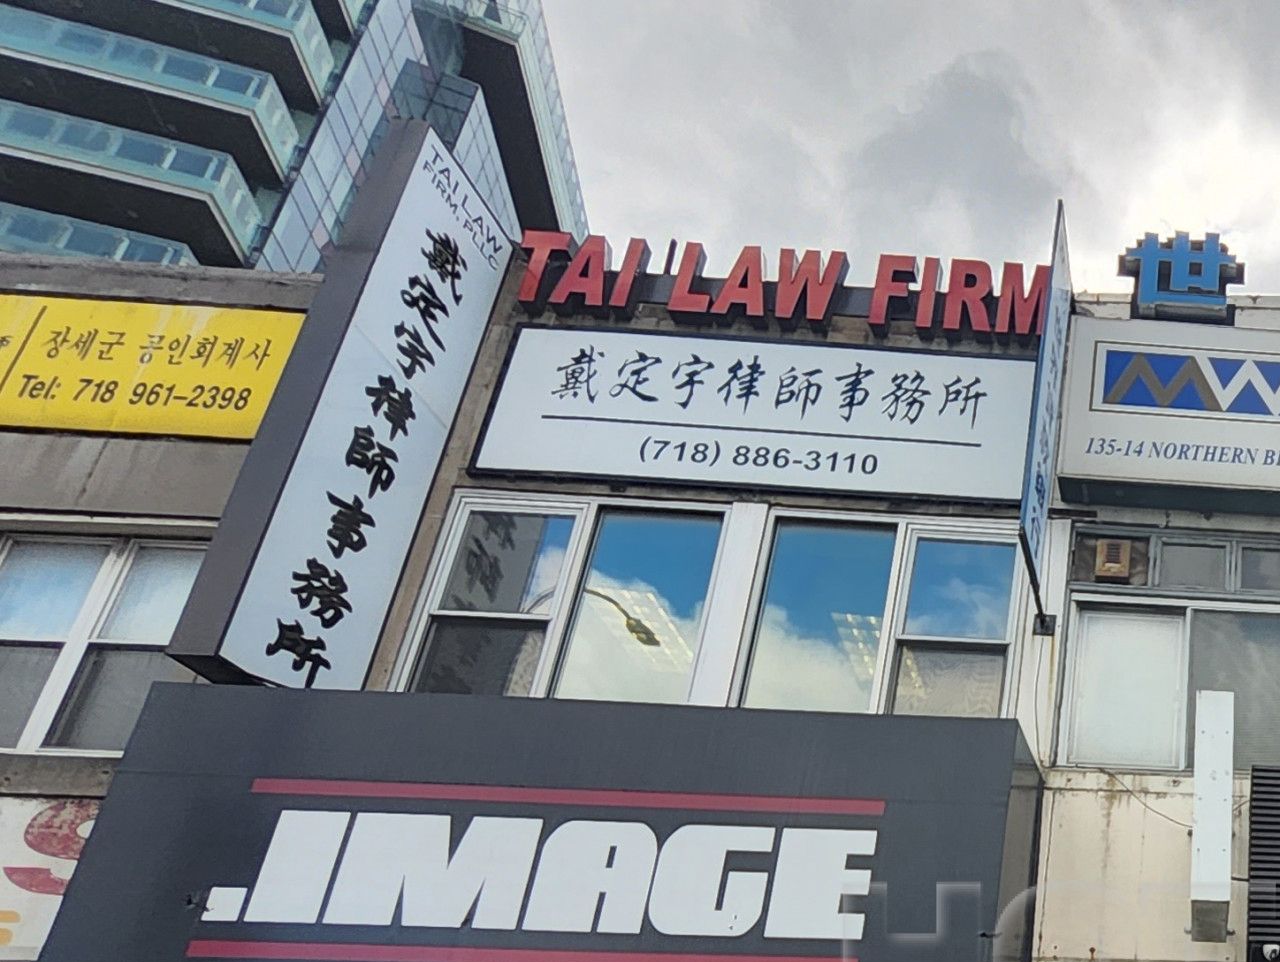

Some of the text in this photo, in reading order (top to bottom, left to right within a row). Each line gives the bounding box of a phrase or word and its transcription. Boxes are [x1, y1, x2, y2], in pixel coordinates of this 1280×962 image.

[430, 144, 503, 254] TAI LAW
[462, 219, 499, 271] PLLC
[519, 230, 1052, 335] TAI LAW FIRM
[46, 326, 126, 361] 장세군
[18, 374, 253, 411] Tel: 718 961-2398
[550, 344, 988, 430] 戴定宇律師事務所
[639, 436, 879, 475] (718) 886-3110
[1085, 436, 1144, 459] 135-14
[1147, 442, 1258, 465] NORTHERN
